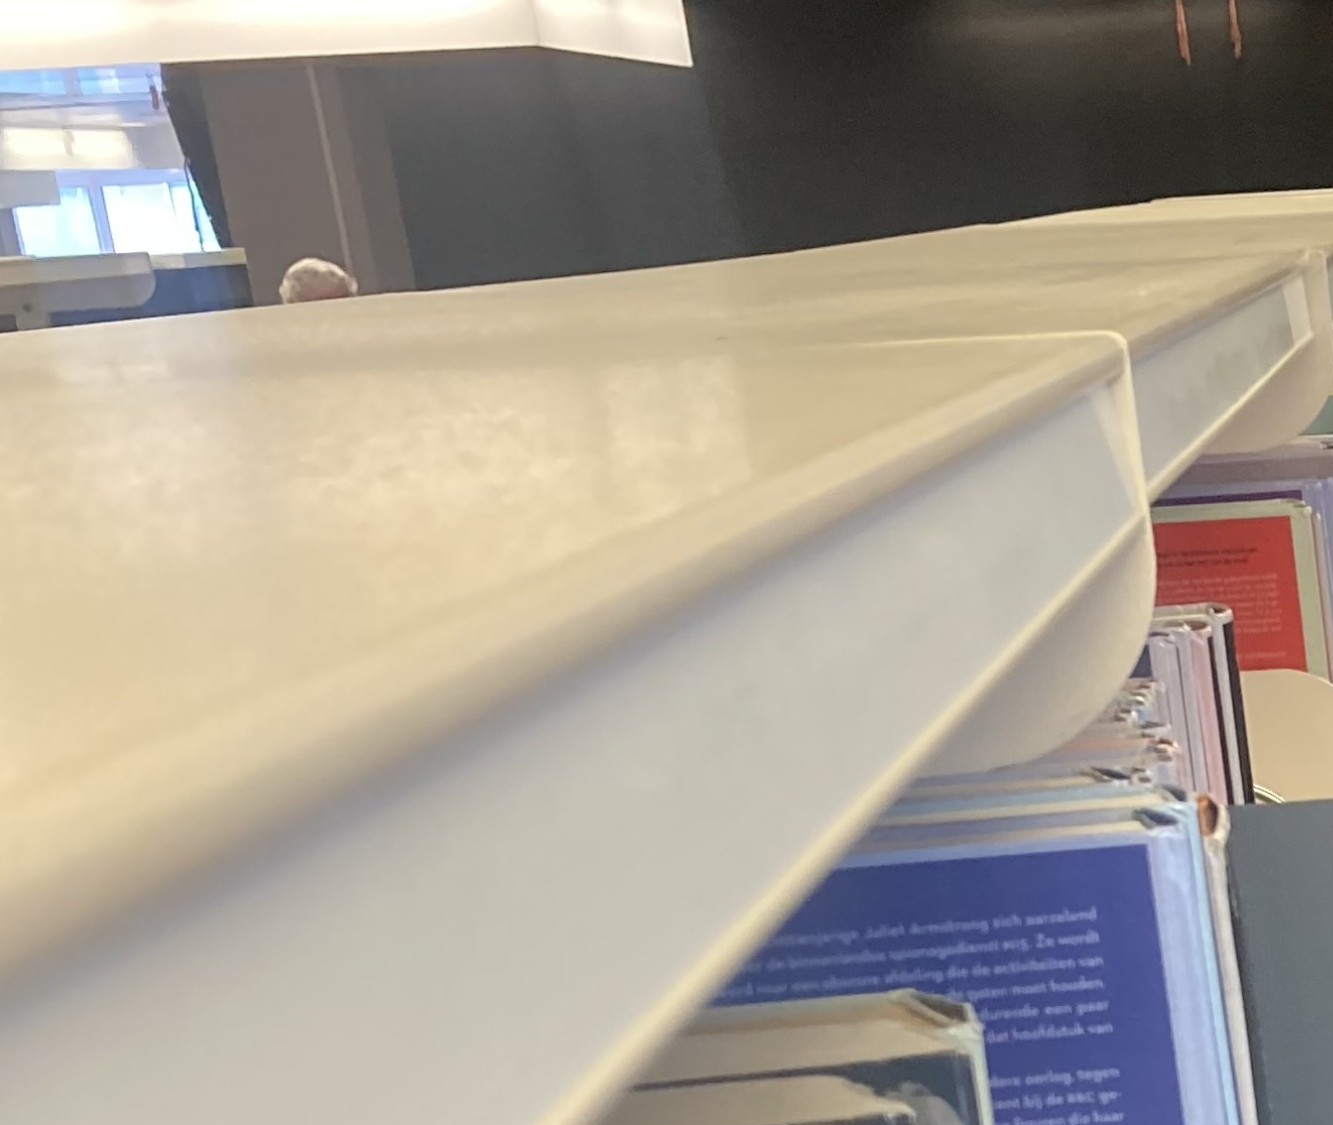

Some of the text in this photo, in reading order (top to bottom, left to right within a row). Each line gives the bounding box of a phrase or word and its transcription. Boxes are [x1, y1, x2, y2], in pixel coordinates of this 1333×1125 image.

[1057, 928, 1100, 946] wordt
[970, 962, 991, 977] de
[992, 956, 1077, 975] activiteiten
[1077, 956, 1105, 968] van
[966, 988, 1008, 1003] gaten
[1012, 982, 1046, 996] moet
[1047, 975, 1104, 992] houden
[1044, 1004, 1073, 1016] een
[1076, 1000, 1108, 1016] paar
[1012, 1021, 1085, 1041] hoofdstuk
[1087, 1022, 1114, 1035] van
[1076, 1068, 1120, 1084] tegen
[1046, 1092, 1064, 1106] de
[1067, 1111, 1091, 1125] die
[1092, 1109, 1124, 1123] haar
